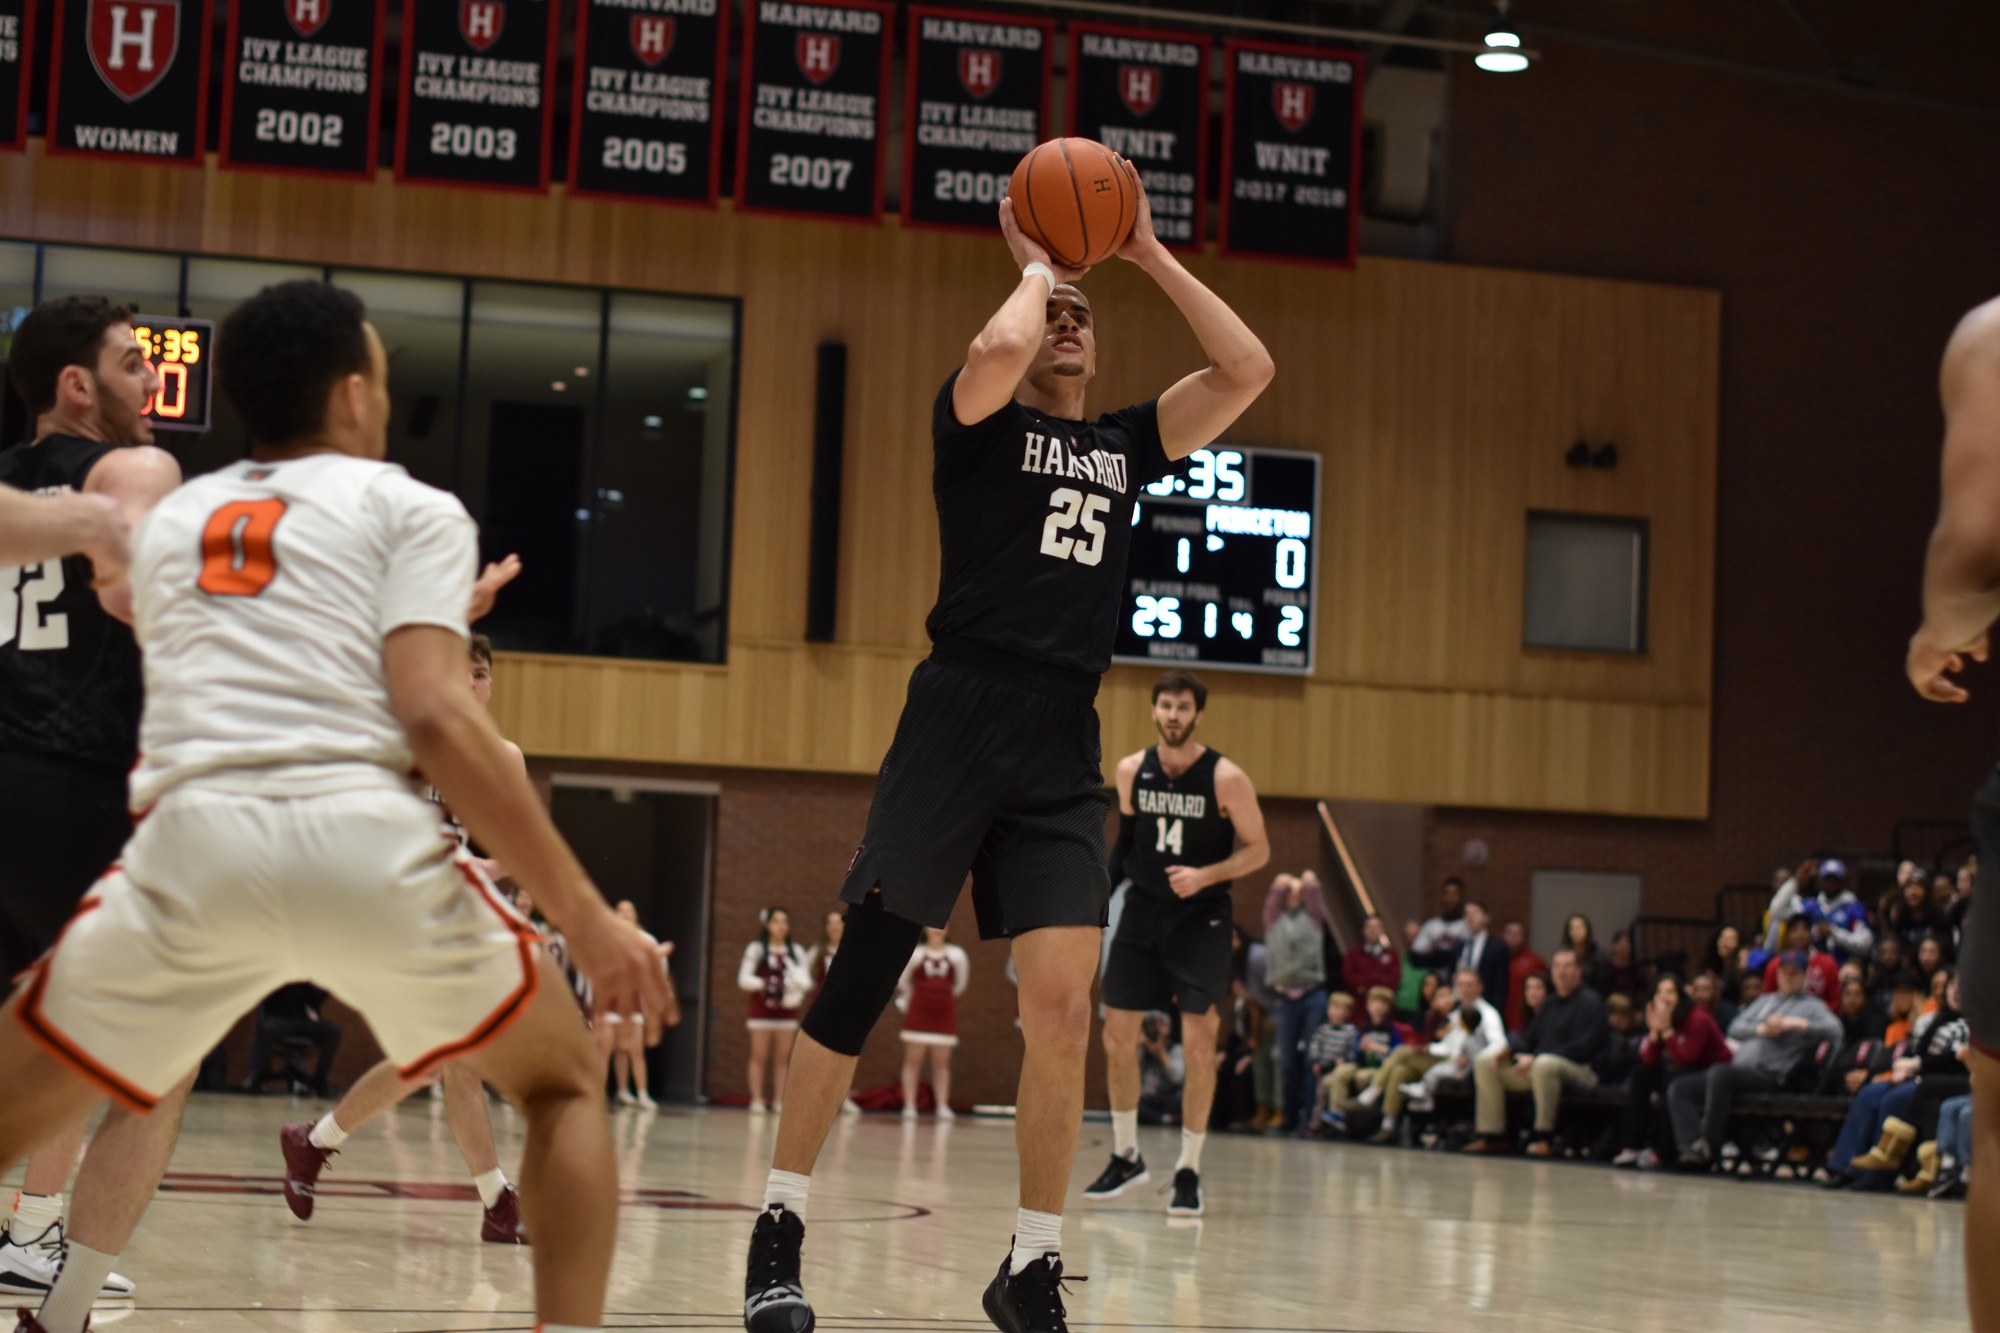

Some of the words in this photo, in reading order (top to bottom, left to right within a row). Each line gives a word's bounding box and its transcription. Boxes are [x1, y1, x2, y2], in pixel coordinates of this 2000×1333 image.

[295, 0, 320, 24] H
[468, 3, 494, 39] H
[593, 0, 716, 16] VARD
[760, 1, 881, 34] HARVARD
[107, 5, 157, 72] H
[639, 18, 665, 53] H
[922, 18, 1041, 49] HARVARD
[1082, 34, 1199, 66] HARVARD
[243, 37, 281, 62] IVY
[285, 43, 367, 70] LEAGUE
[418, 51, 456, 76] IVY
[460, 57, 540, 84] LEAGUE
[805, 36, 831, 71] H
[967, 52, 992, 86] H
[1237, 51, 1353, 83] HARVARD
[239, 60, 367, 94] CHAMPIONS
[414, 75, 540, 108] CHAMPIONS
[590, 66, 628, 91] IVY
[631, 71, 710, 99] LEAGUE
[1127, 70, 1152, 103] H
[587, 90, 709, 123] CHAMPIONS
[758, 83, 794, 108] IVY
[797, 88, 876, 117] LEAGUE
[921, 101, 957, 125] IVY
[959, 105, 1036, 132] LEAGUE
[1280, 86, 1306, 119] H
[75, 125, 179, 155] WOMEN
[255, 108, 343, 147] 2002
[754, 107, 875, 140] CHAMPIONS
[918, 124, 1037, 153] CHAMPIONS
[430, 122, 517, 160] 2003
[602, 136, 687, 175] 2005
[1100, 126, 1177, 160] WNIT
[769, 153, 853, 191] 2007
[1254, 141, 1330, 176] WNIT
[1093, 178, 1111, 194] H
[1234, 178, 1288, 203] 2017
[1154, 218, 1193, 240] 016
[1040, 486, 1111, 567] 25
[1205, 504, 1311, 540] PRINCETON
[195, 496, 288, 598] 0
[1176, 537, 1191, 574] 1
[1274, 537, 1307, 590] 0
[1131, 594, 1183, 639] 25
[1203, 601, 1218, 639] 1
[1277, 604, 1305, 647] 2
[1138, 789, 1206, 818] HARVARD
[1155, 816, 1184, 856] 14
